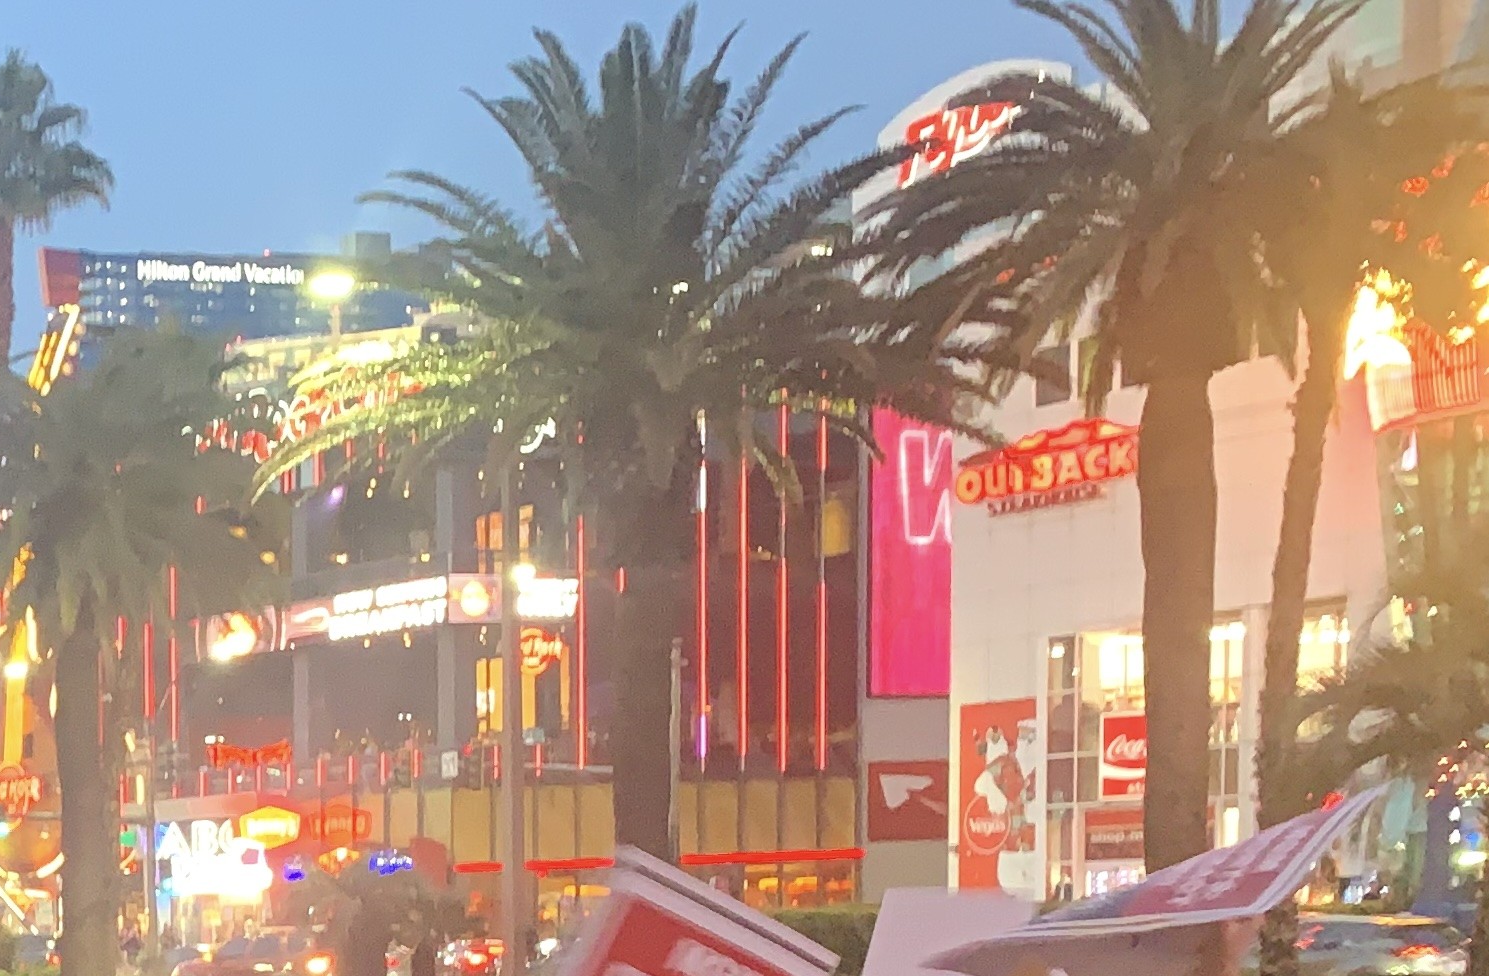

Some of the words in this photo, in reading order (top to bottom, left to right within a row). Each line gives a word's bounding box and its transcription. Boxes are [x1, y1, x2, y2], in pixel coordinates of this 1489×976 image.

[137, 259, 190, 281] Hilton
[192, 261, 241, 283] Grand
[969, 816, 1007, 836] Vegas
